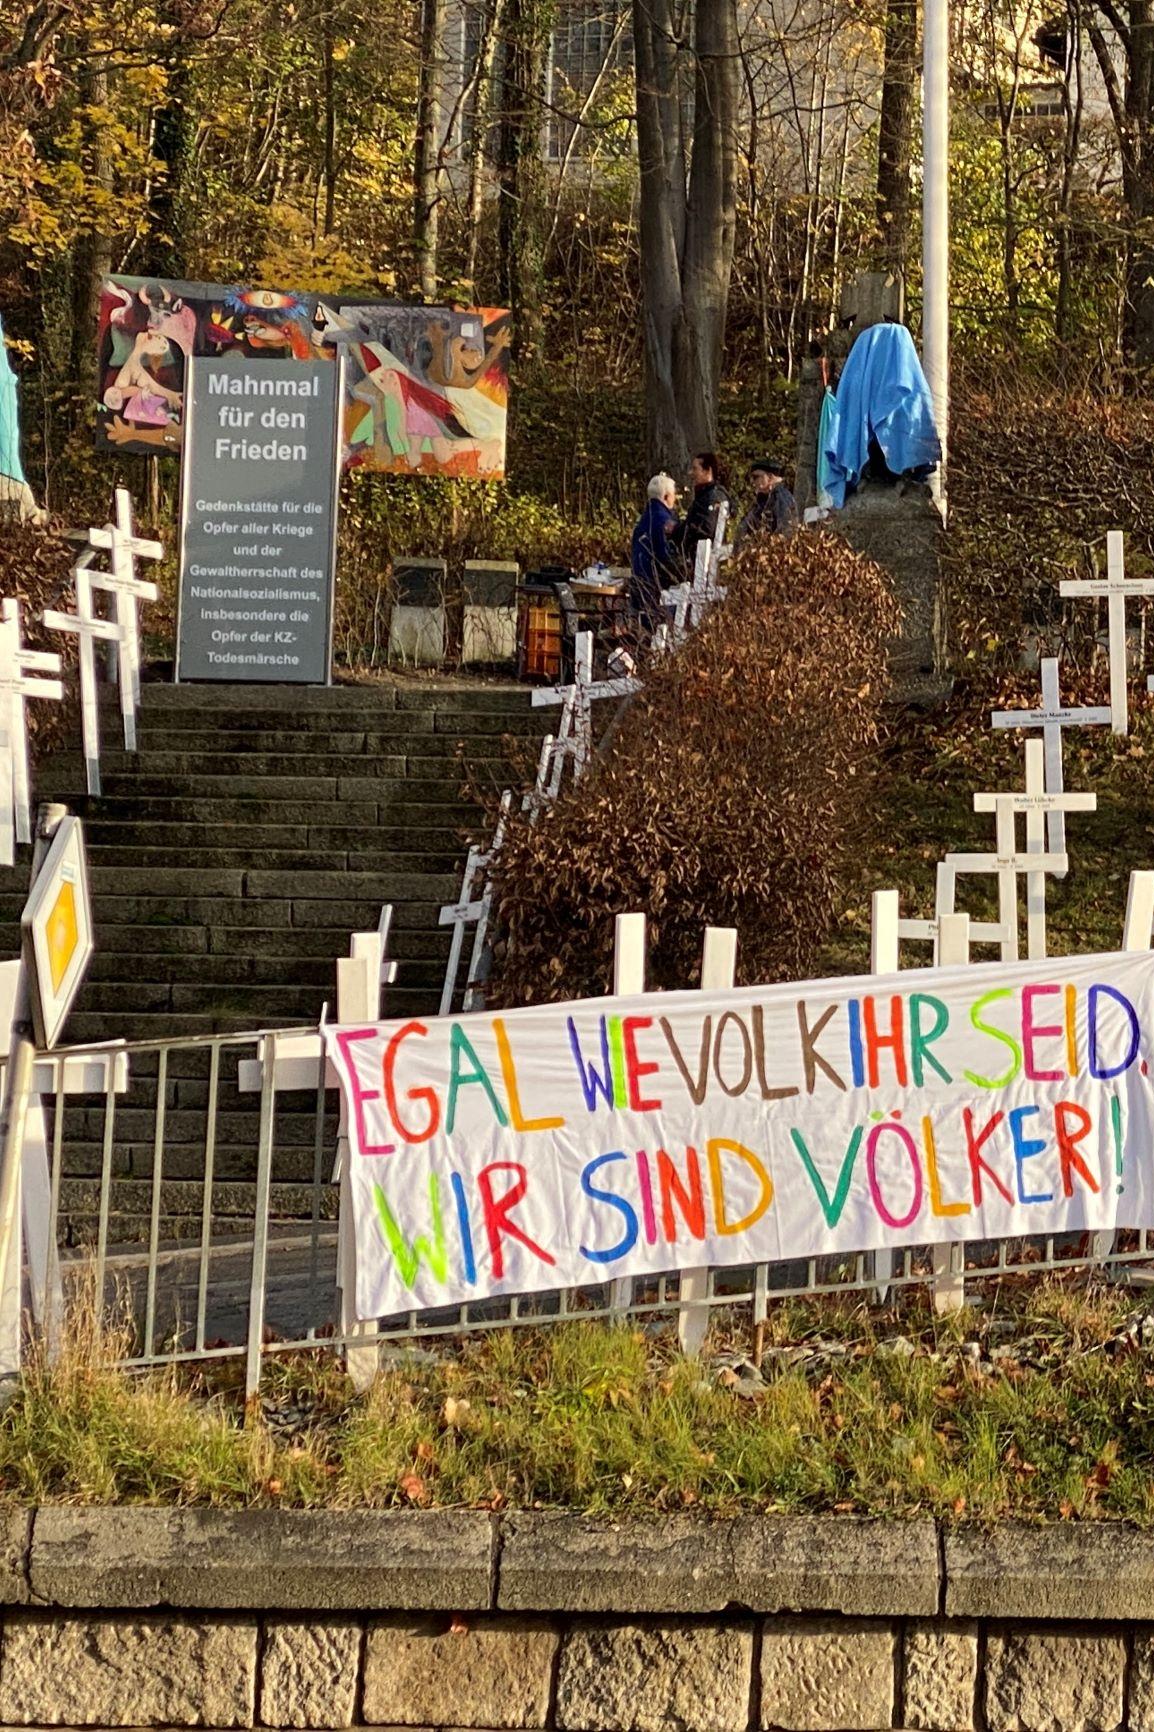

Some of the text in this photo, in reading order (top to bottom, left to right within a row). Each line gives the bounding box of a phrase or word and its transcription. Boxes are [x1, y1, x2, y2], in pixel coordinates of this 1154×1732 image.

[208, 373, 319, 397] Mahnmal
[218, 405, 306, 429] für den
[215, 438, 307, 461] Frieden
[195, 499, 323, 514] Gedenkstätte für die
[203, 521, 314, 538] Opfer aller Kriege
[233, 544, 282, 556] und der
[189, 564, 324, 579] Gewaltherrschaft des
[190, 586, 321, 602] Nationalsozialismus,
[289, 610, 310, 622] die
[211, 629, 298, 644] Opfer der KZ-
[207, 651, 300, 666] Todesmärsche
[336, 1020, 566, 1156] EGAL
[658, 999, 847, 1106] VOLK
[847, 993, 954, 1089] IHR
[963, 982, 1150, 1091] SEID.
[372, 1094, 1126, 1290] WIR SIND VÖLKER!
